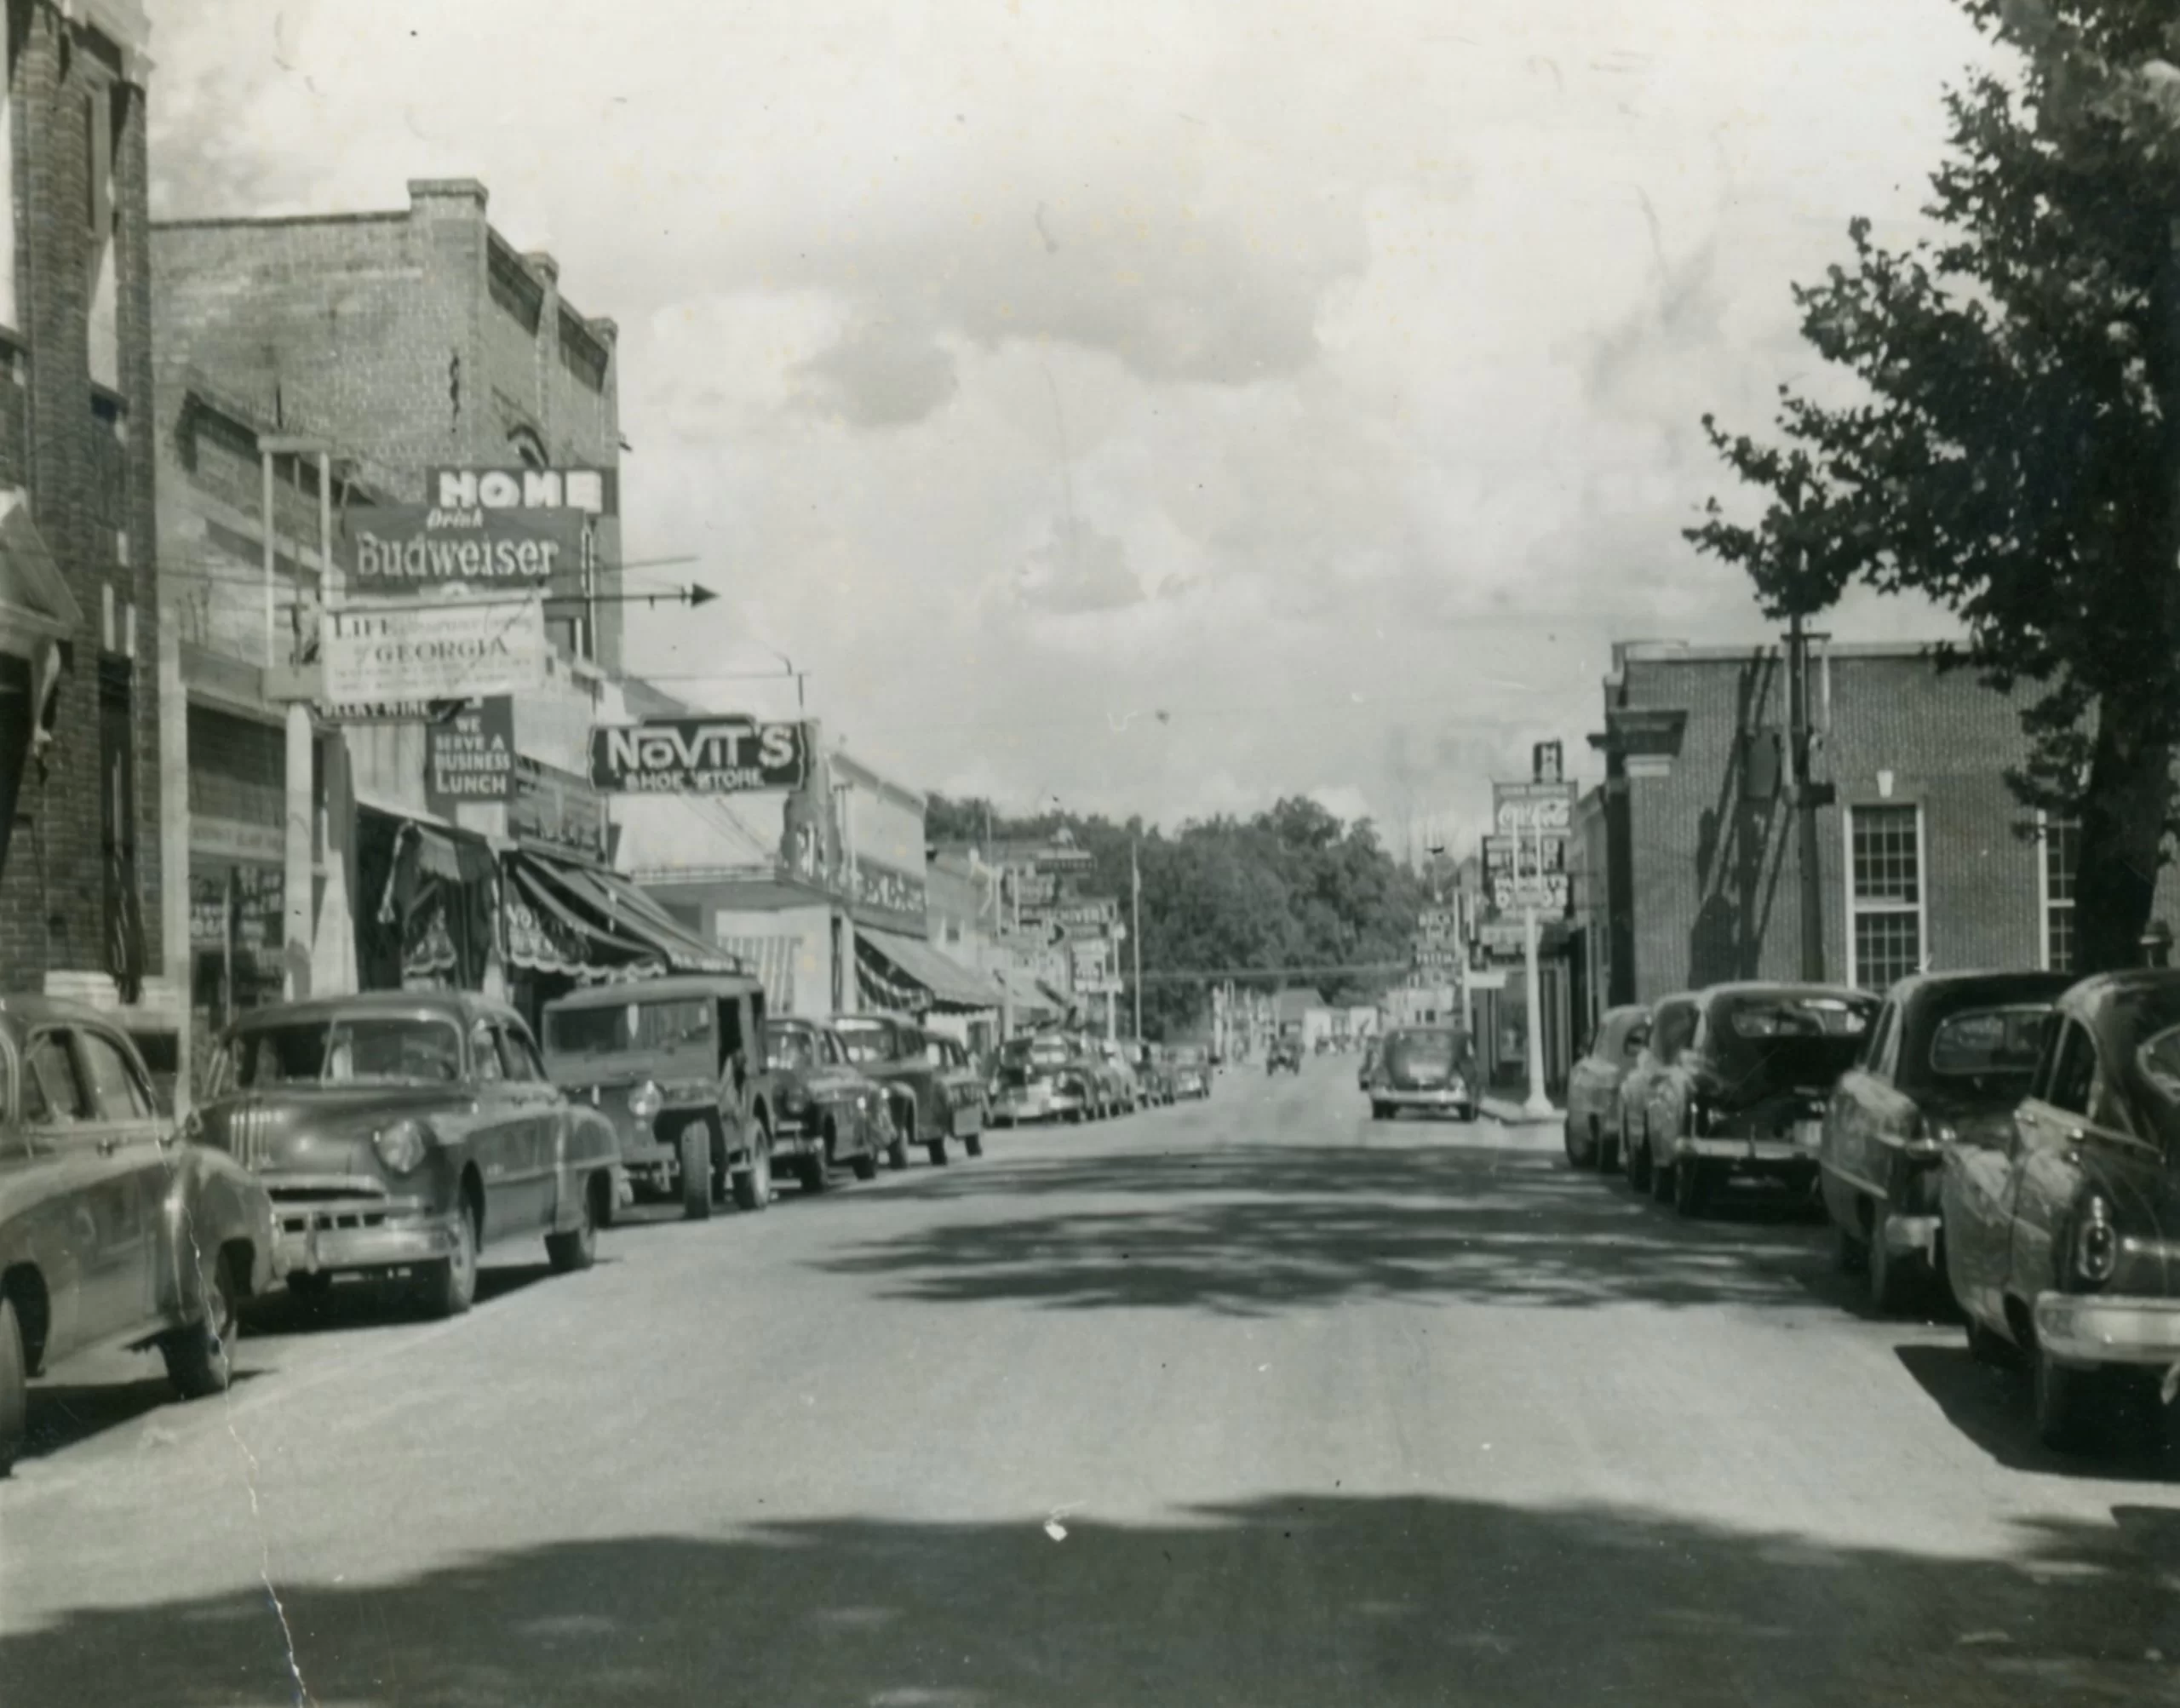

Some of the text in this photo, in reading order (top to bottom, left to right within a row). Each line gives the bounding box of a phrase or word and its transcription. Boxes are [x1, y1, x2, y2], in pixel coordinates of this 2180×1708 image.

[439, 470, 603, 513] HOME
[427, 507, 484, 530] Drink
[356, 530, 559, 576] Budweiser
[374, 637, 509, 662] GEORGIA
[455, 716, 481, 733] WE
[435, 732, 505, 751] SERVE A
[433, 751, 511, 771] BUSINESS
[436, 769, 507, 794] LUNCH
[624, 767, 766, 792] SHOE STORE
